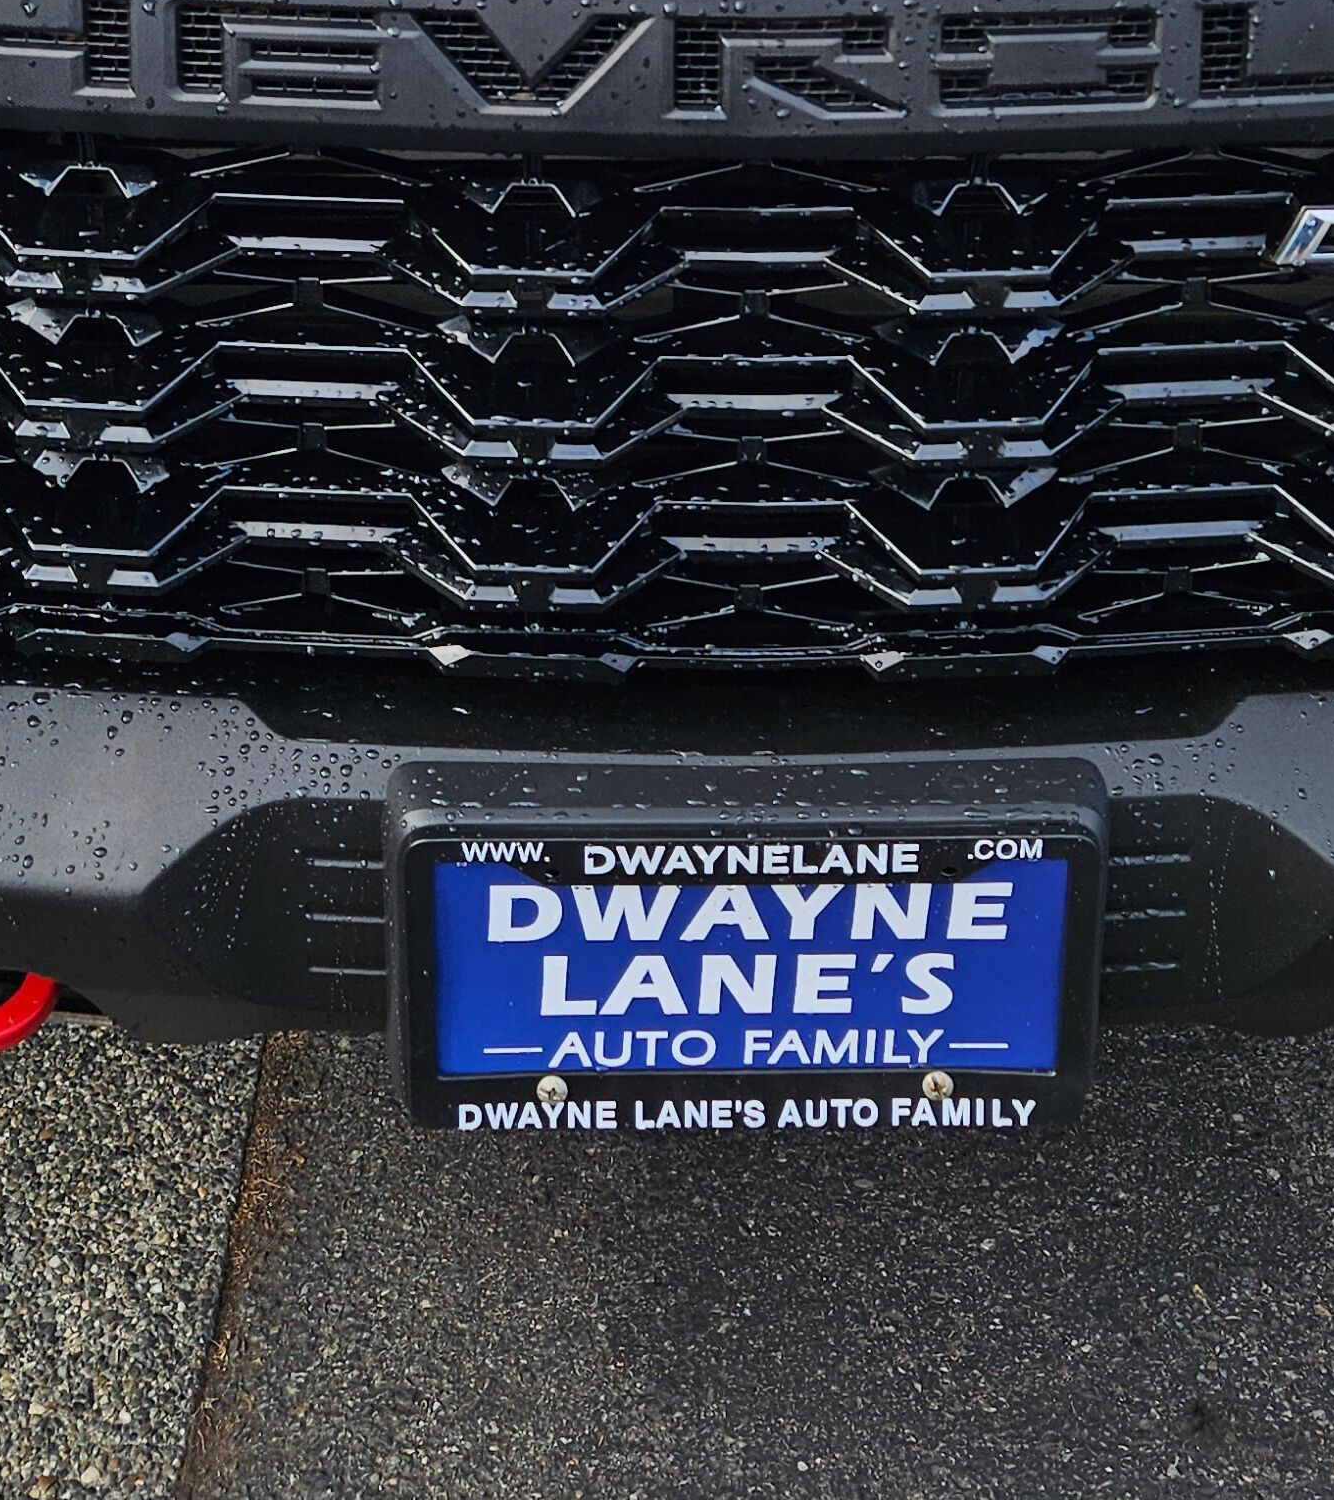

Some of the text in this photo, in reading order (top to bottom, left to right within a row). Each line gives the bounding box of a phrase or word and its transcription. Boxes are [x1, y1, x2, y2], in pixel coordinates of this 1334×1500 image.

[584, 843, 921, 876] DWAYNELANE
[966, 838, 1044, 861] .COM
[487, 883, 1014, 942] DWAYNE
[540, 952, 955, 1017] LANE'S
[548, 1028, 945, 1068] AUTO FAMILY
[458, 1097, 1037, 1131] DWAYNE LANE'S AUTO FAMILY
